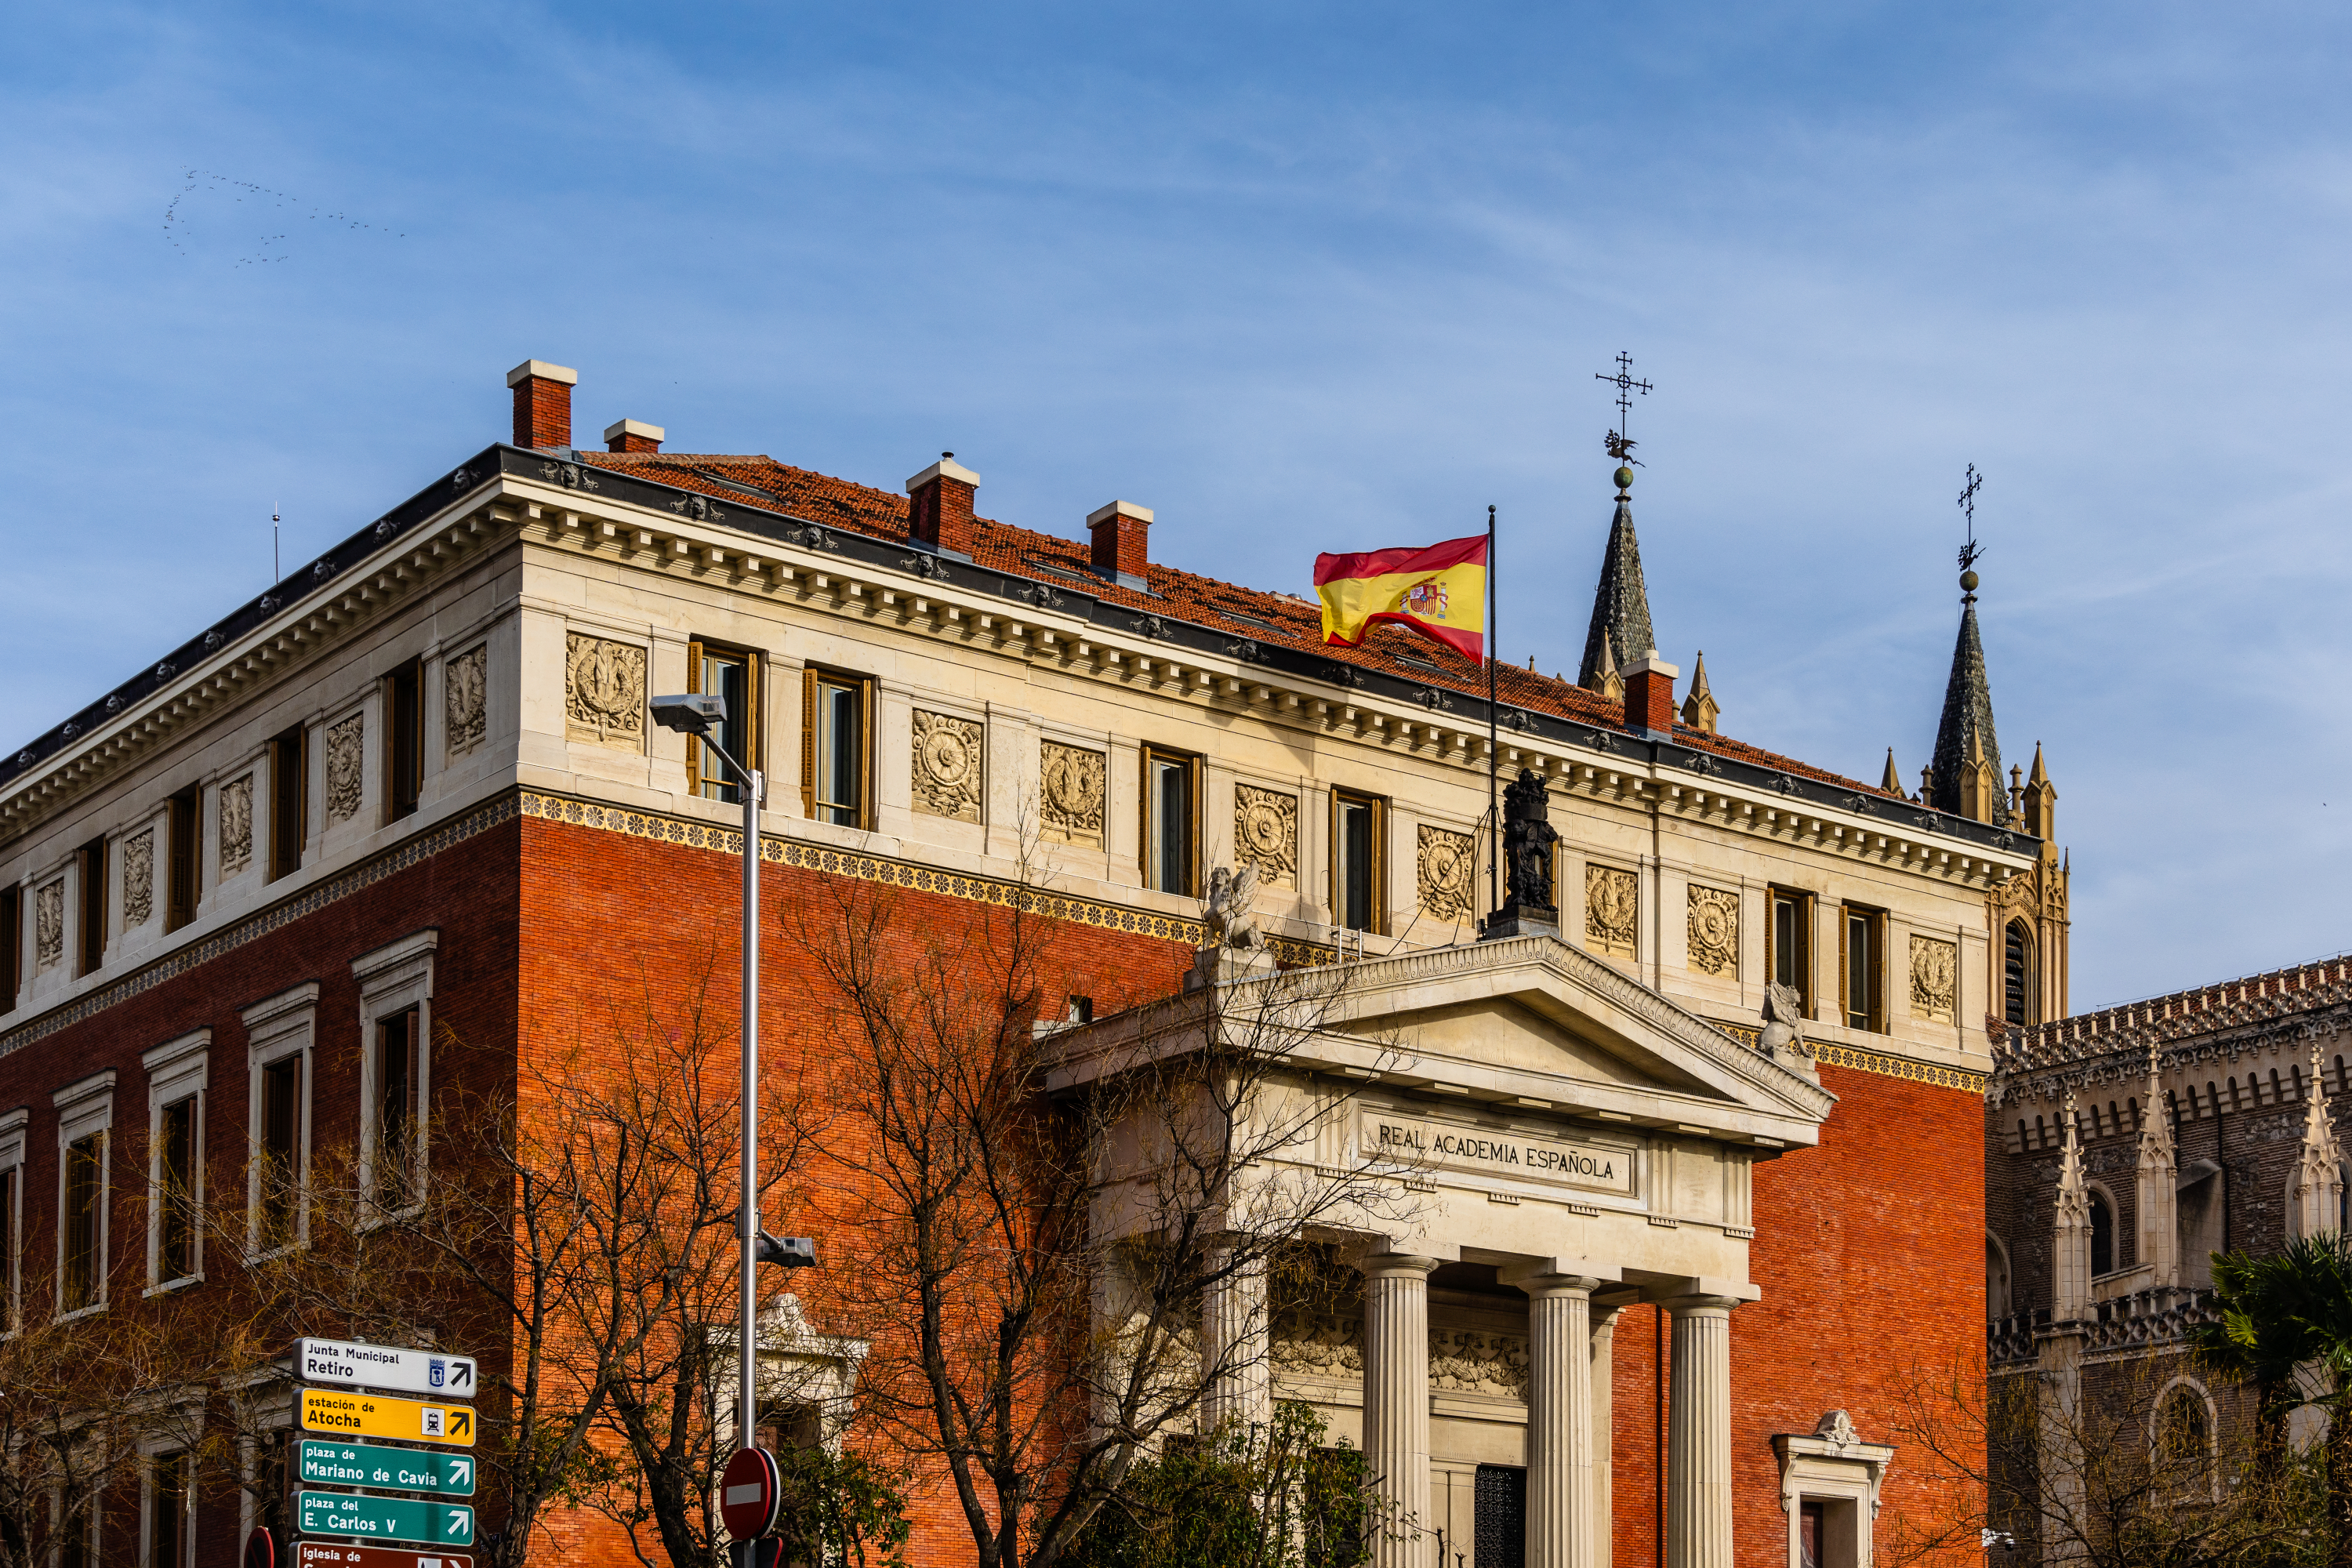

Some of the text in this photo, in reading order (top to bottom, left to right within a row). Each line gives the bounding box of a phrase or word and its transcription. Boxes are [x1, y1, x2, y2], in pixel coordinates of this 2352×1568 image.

[1379, 1124, 1613, 1179] REAL ACADEMIA ESPAÑOLA
[308, 1343, 399, 1364] Junta Municipal
[307, 1358, 354, 1377] Retiro
[308, 1397, 375, 1413] estación de
[307, 1410, 361, 1428] Atocha
[306, 1446, 356, 1461] plaza de
[305, 1461, 437, 1486] Mariano de Cavia
[304, 1497, 359, 1512] plaza del
[304, 1512, 397, 1533] E. Carlos V
[303, 1547, 361, 1563] iglesia de
